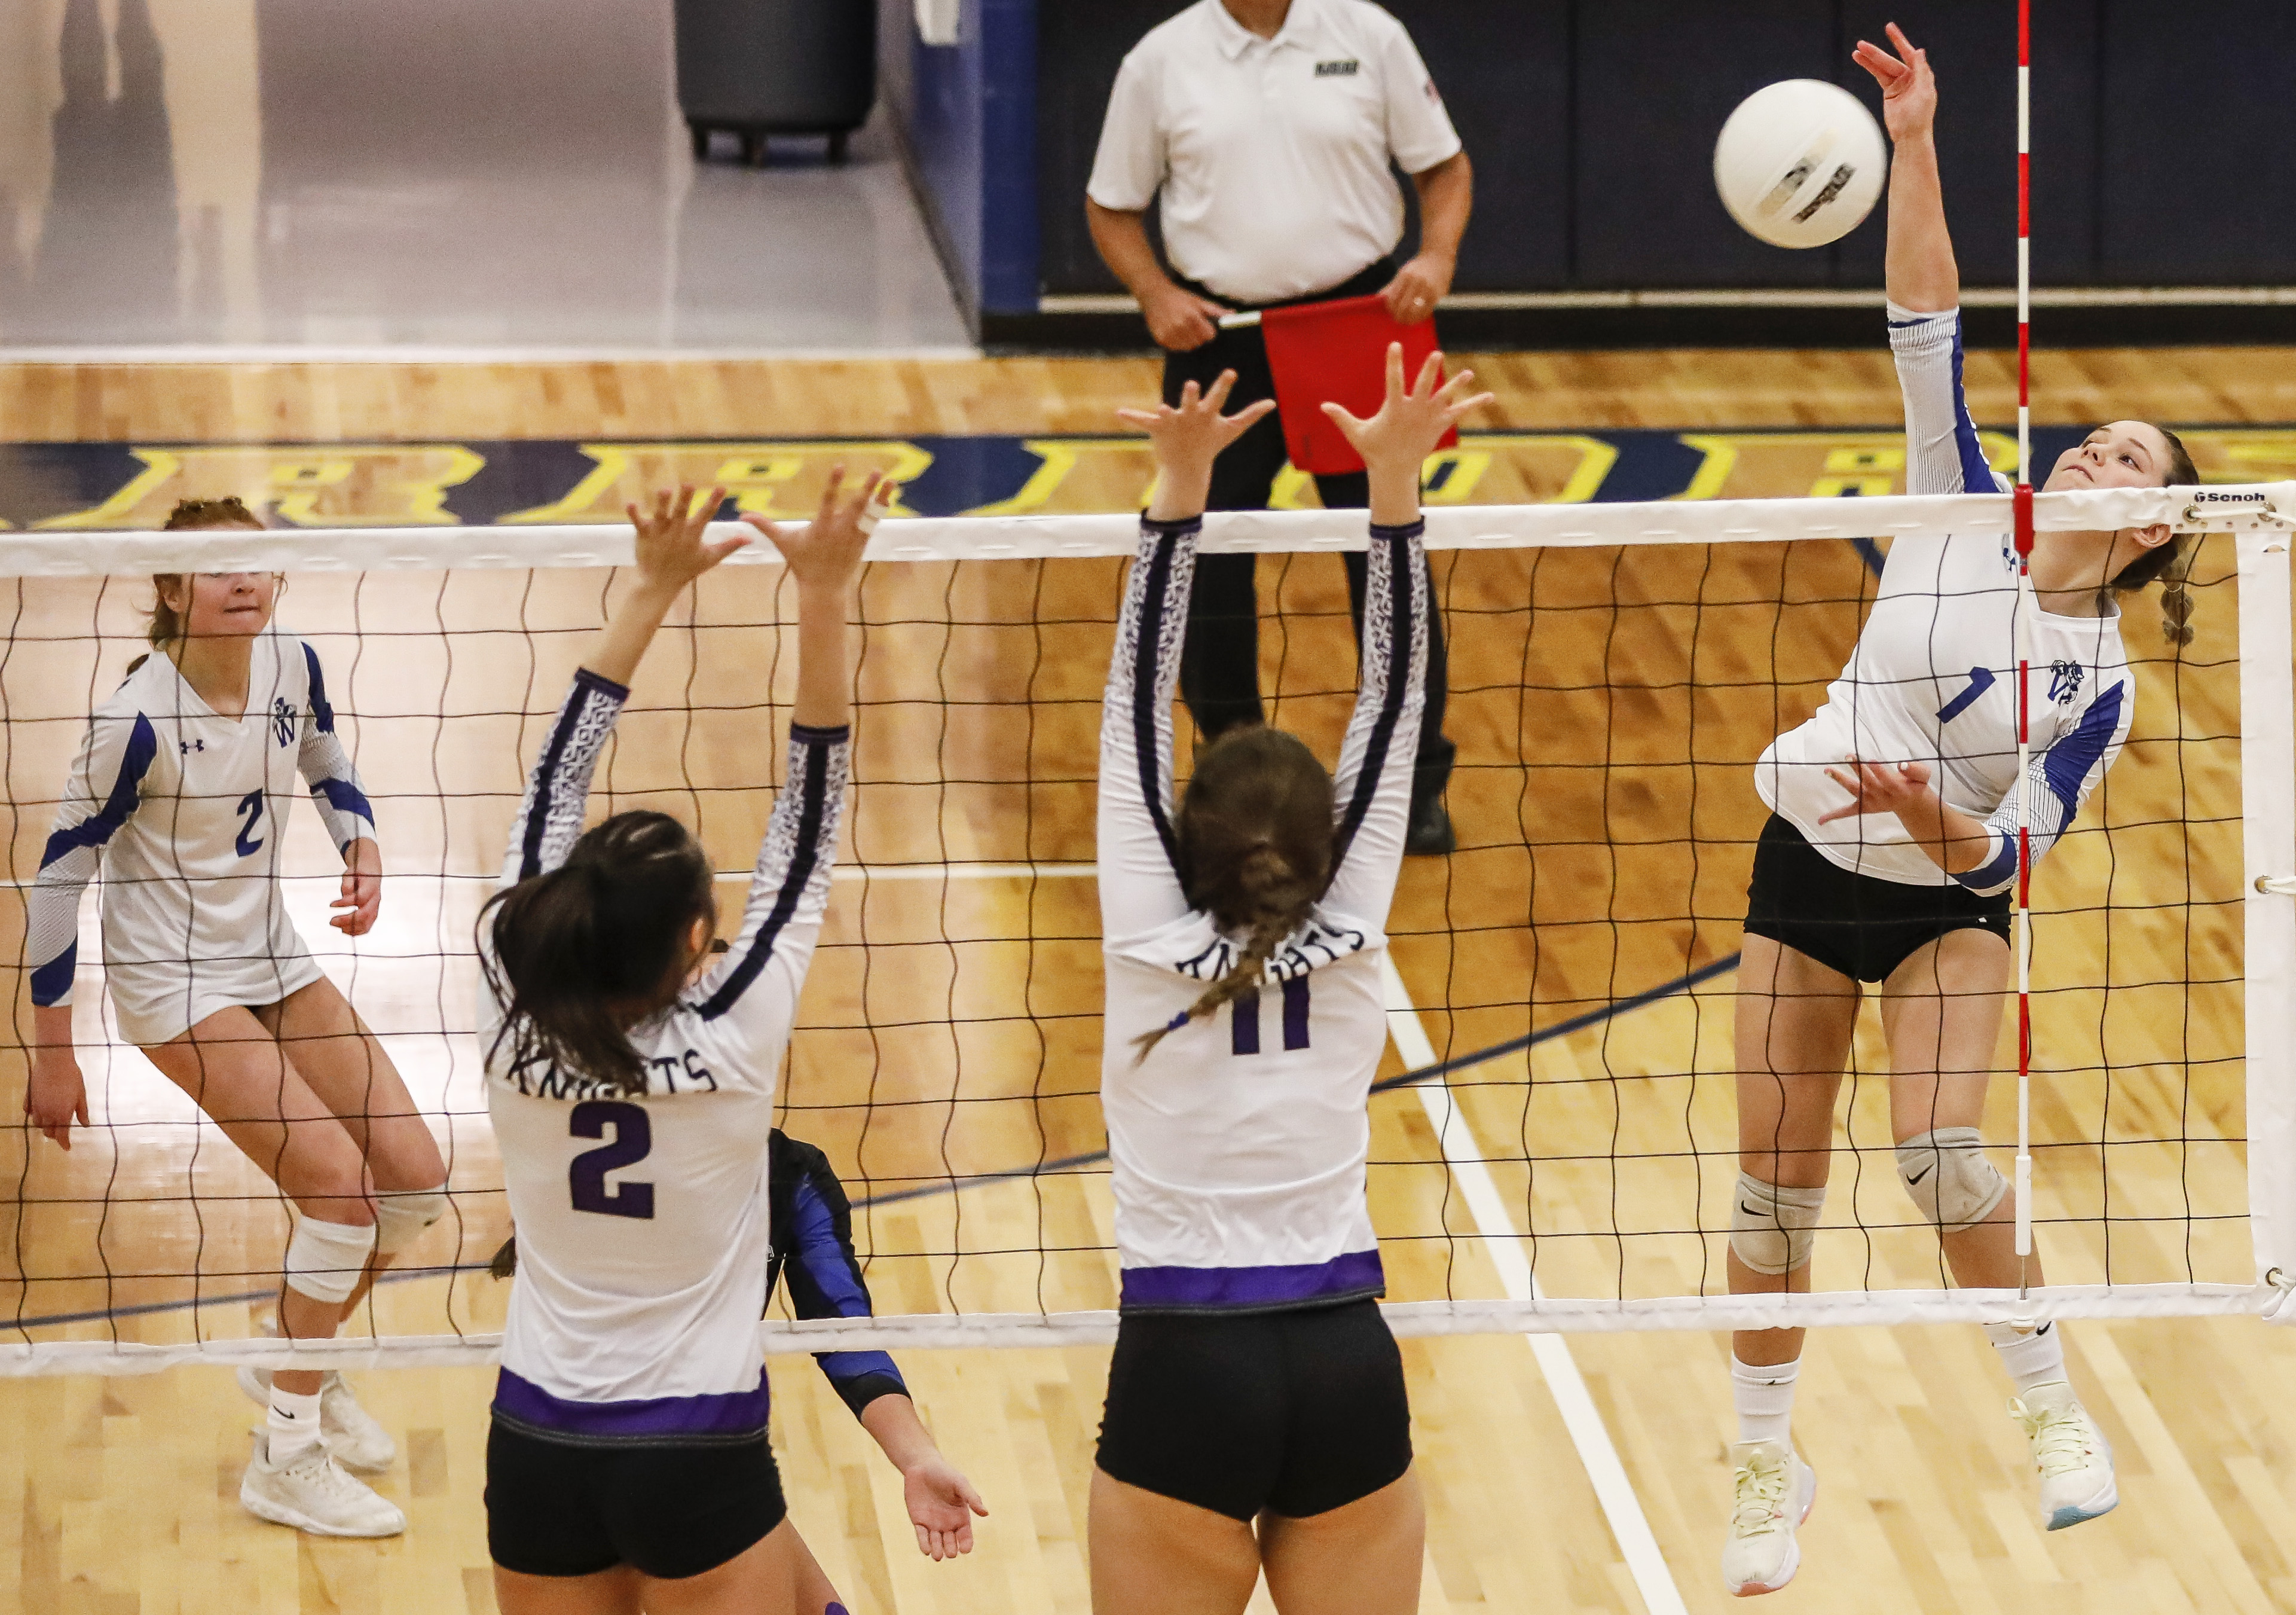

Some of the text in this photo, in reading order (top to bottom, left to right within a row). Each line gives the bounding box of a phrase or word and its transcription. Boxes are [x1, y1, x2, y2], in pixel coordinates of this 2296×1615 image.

[2207, 492, 2266, 502] Senoh
[1936, 666, 1996, 723] 1
[236, 787, 264, 857] 2
[1232, 973, 1310, 1055] 11
[569, 1100, 655, 1219] 2
